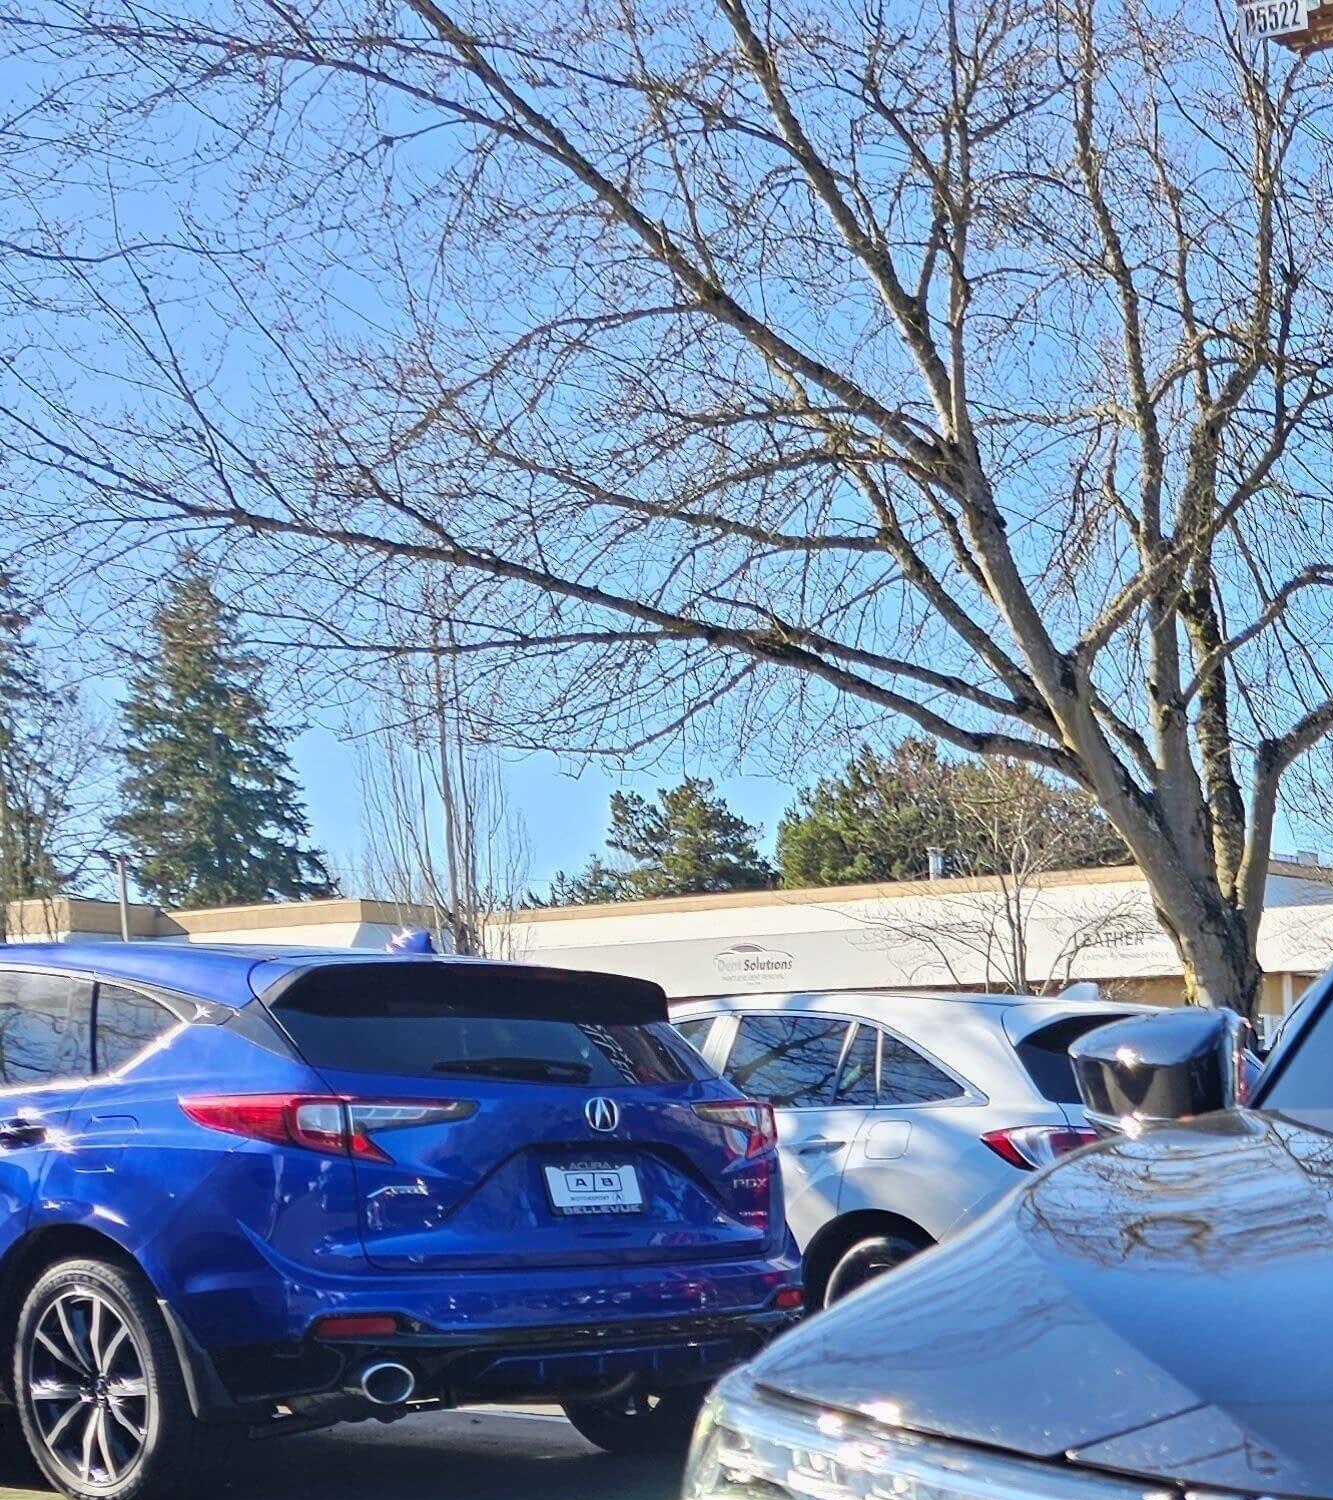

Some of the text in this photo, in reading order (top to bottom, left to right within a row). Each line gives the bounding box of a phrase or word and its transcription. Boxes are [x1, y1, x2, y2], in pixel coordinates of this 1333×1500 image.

[744, 956, 793, 972] Solutions
[570, 1161, 612, 1170] ACURA
[563, 1203, 641, 1216] BELLEVUE
